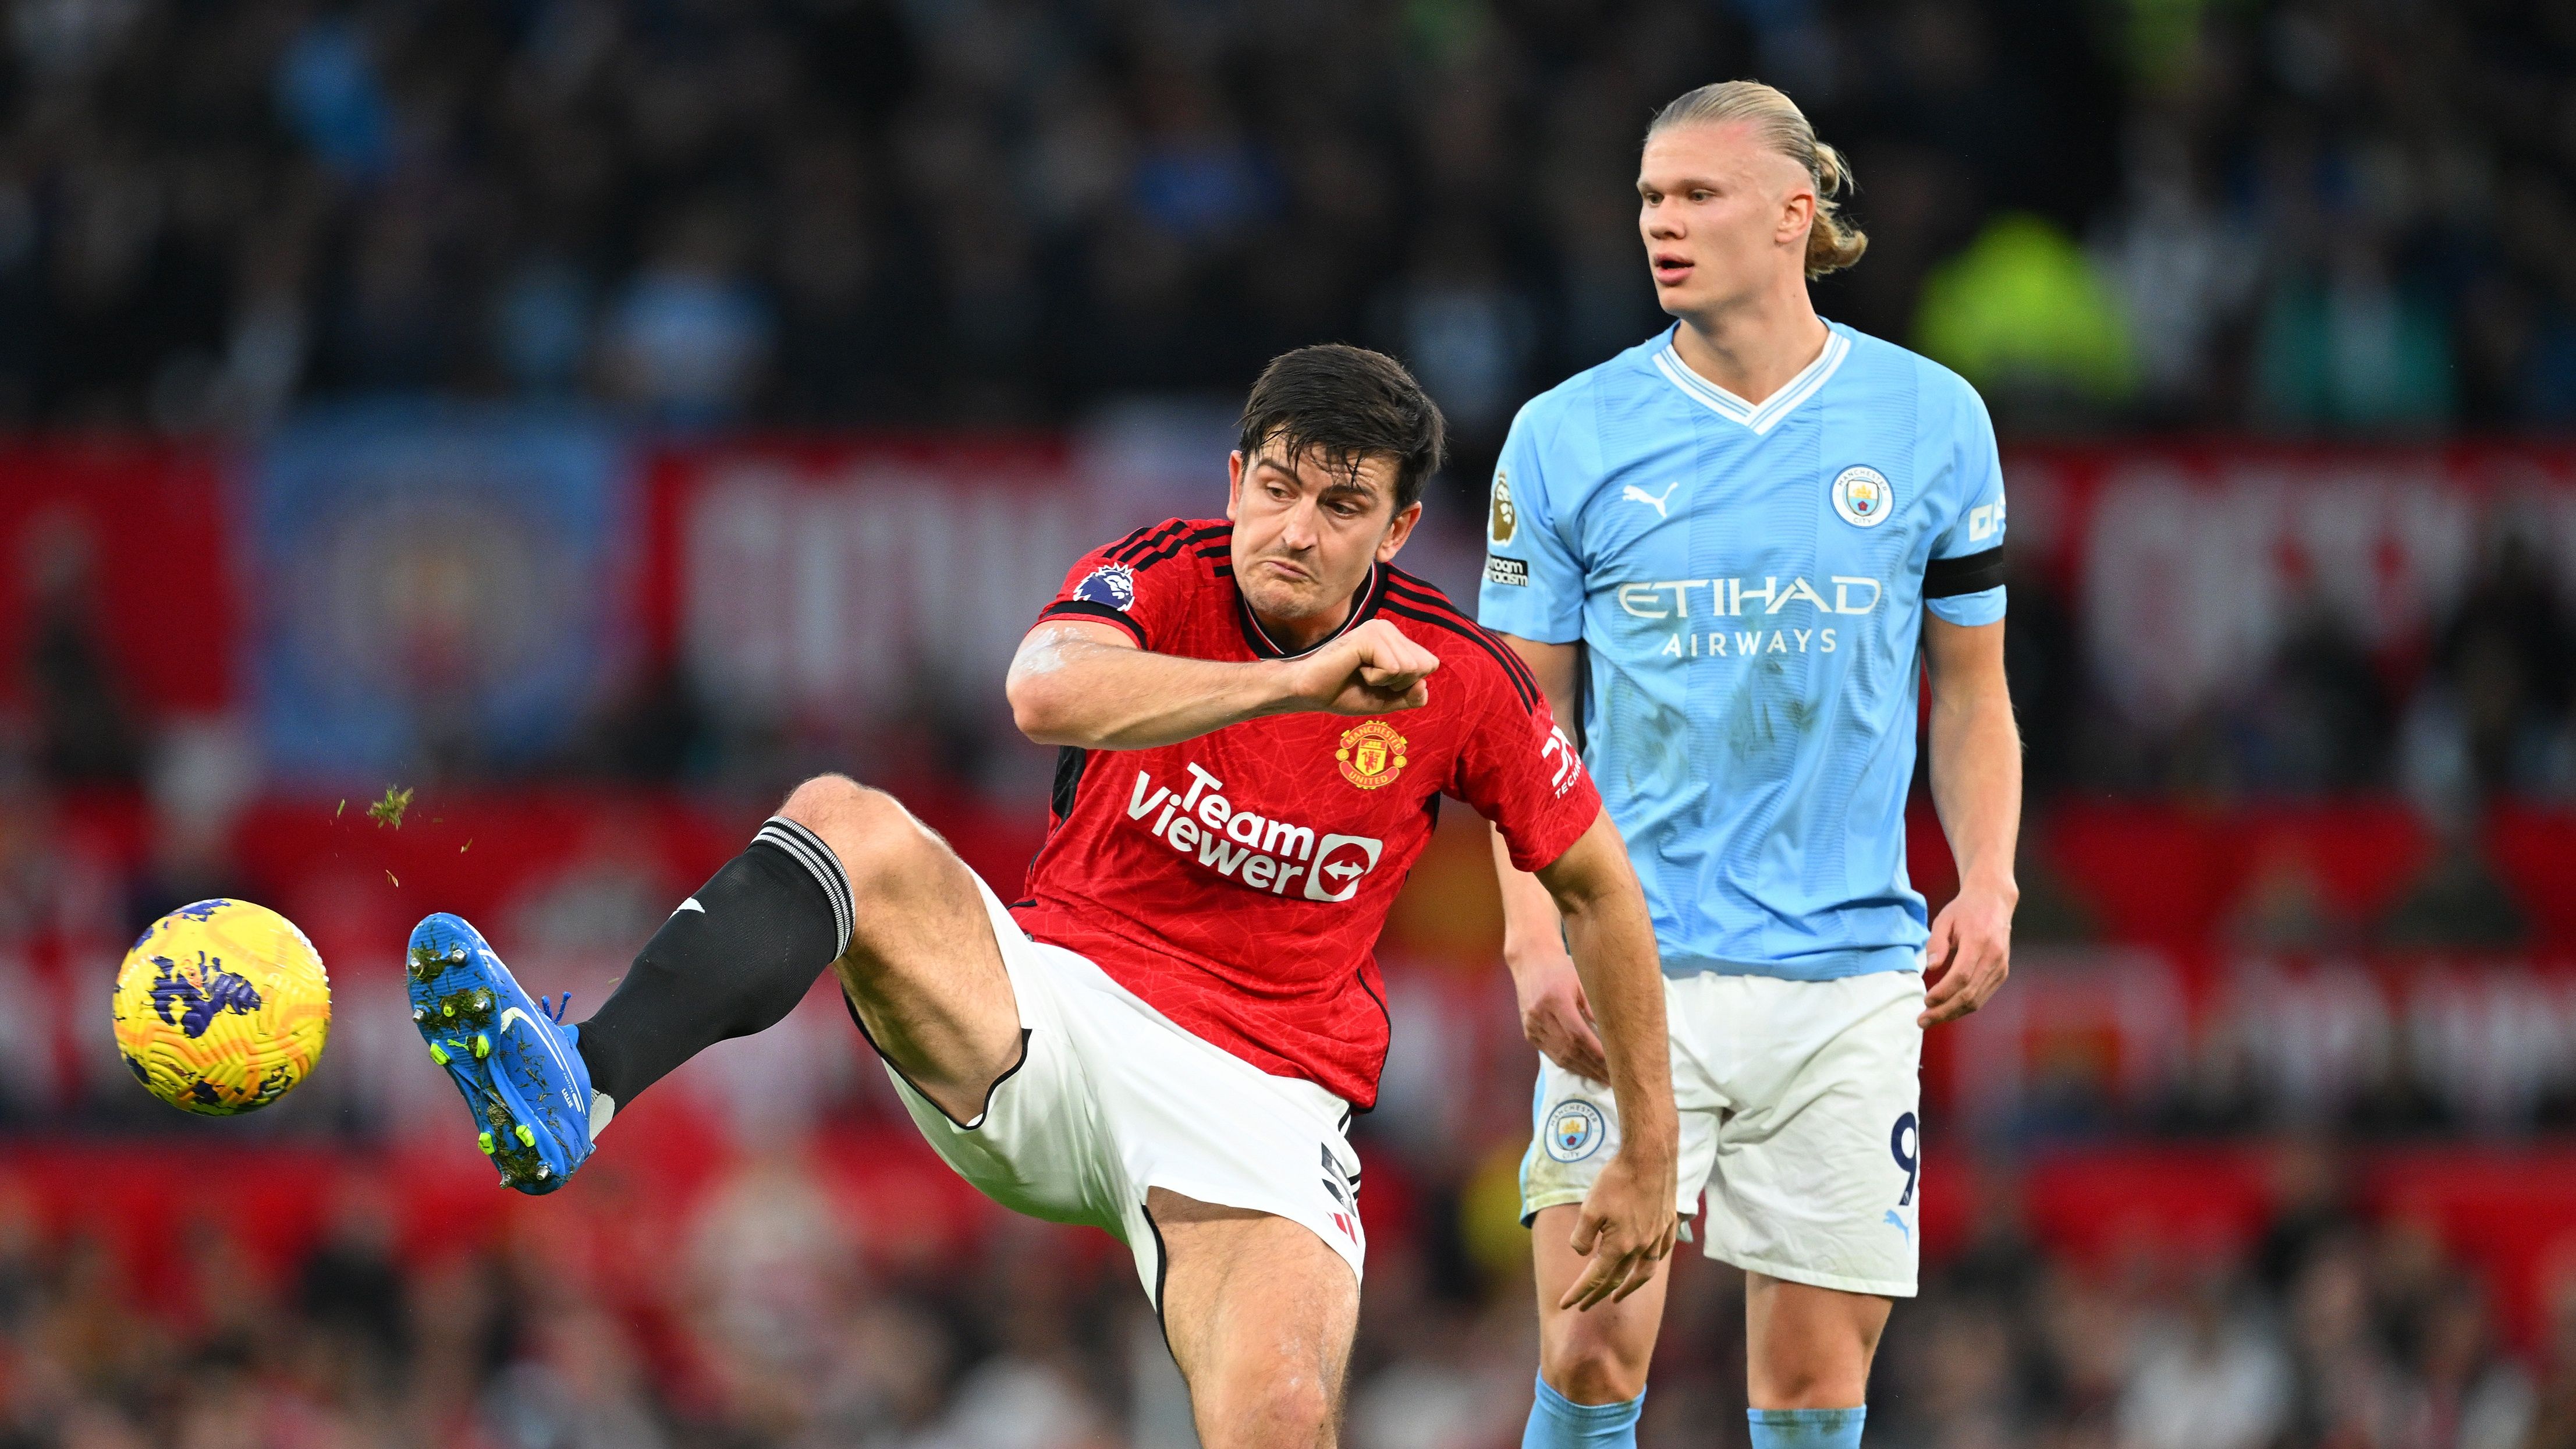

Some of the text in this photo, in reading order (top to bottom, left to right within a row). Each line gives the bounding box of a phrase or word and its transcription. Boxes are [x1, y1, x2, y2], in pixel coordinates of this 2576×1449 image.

[1838, 469, 1887, 491] MANCHESTER
[1617, 576, 1882, 619] ETIHAD
[1661, 628, 1837, 658] AIRWAYS
[1345, 725, 1401, 751] MANCHESTER
[1348, 770, 1388, 785] UNITED
[1181, 761, 1315, 861] Team
[1127, 770, 1304, 895] Viewer
[561, 1087, 574, 1108] LILLIE
[1550, 1105, 1598, 1126] MANCHESTER
[1890, 1111, 1917, 1206] 9
